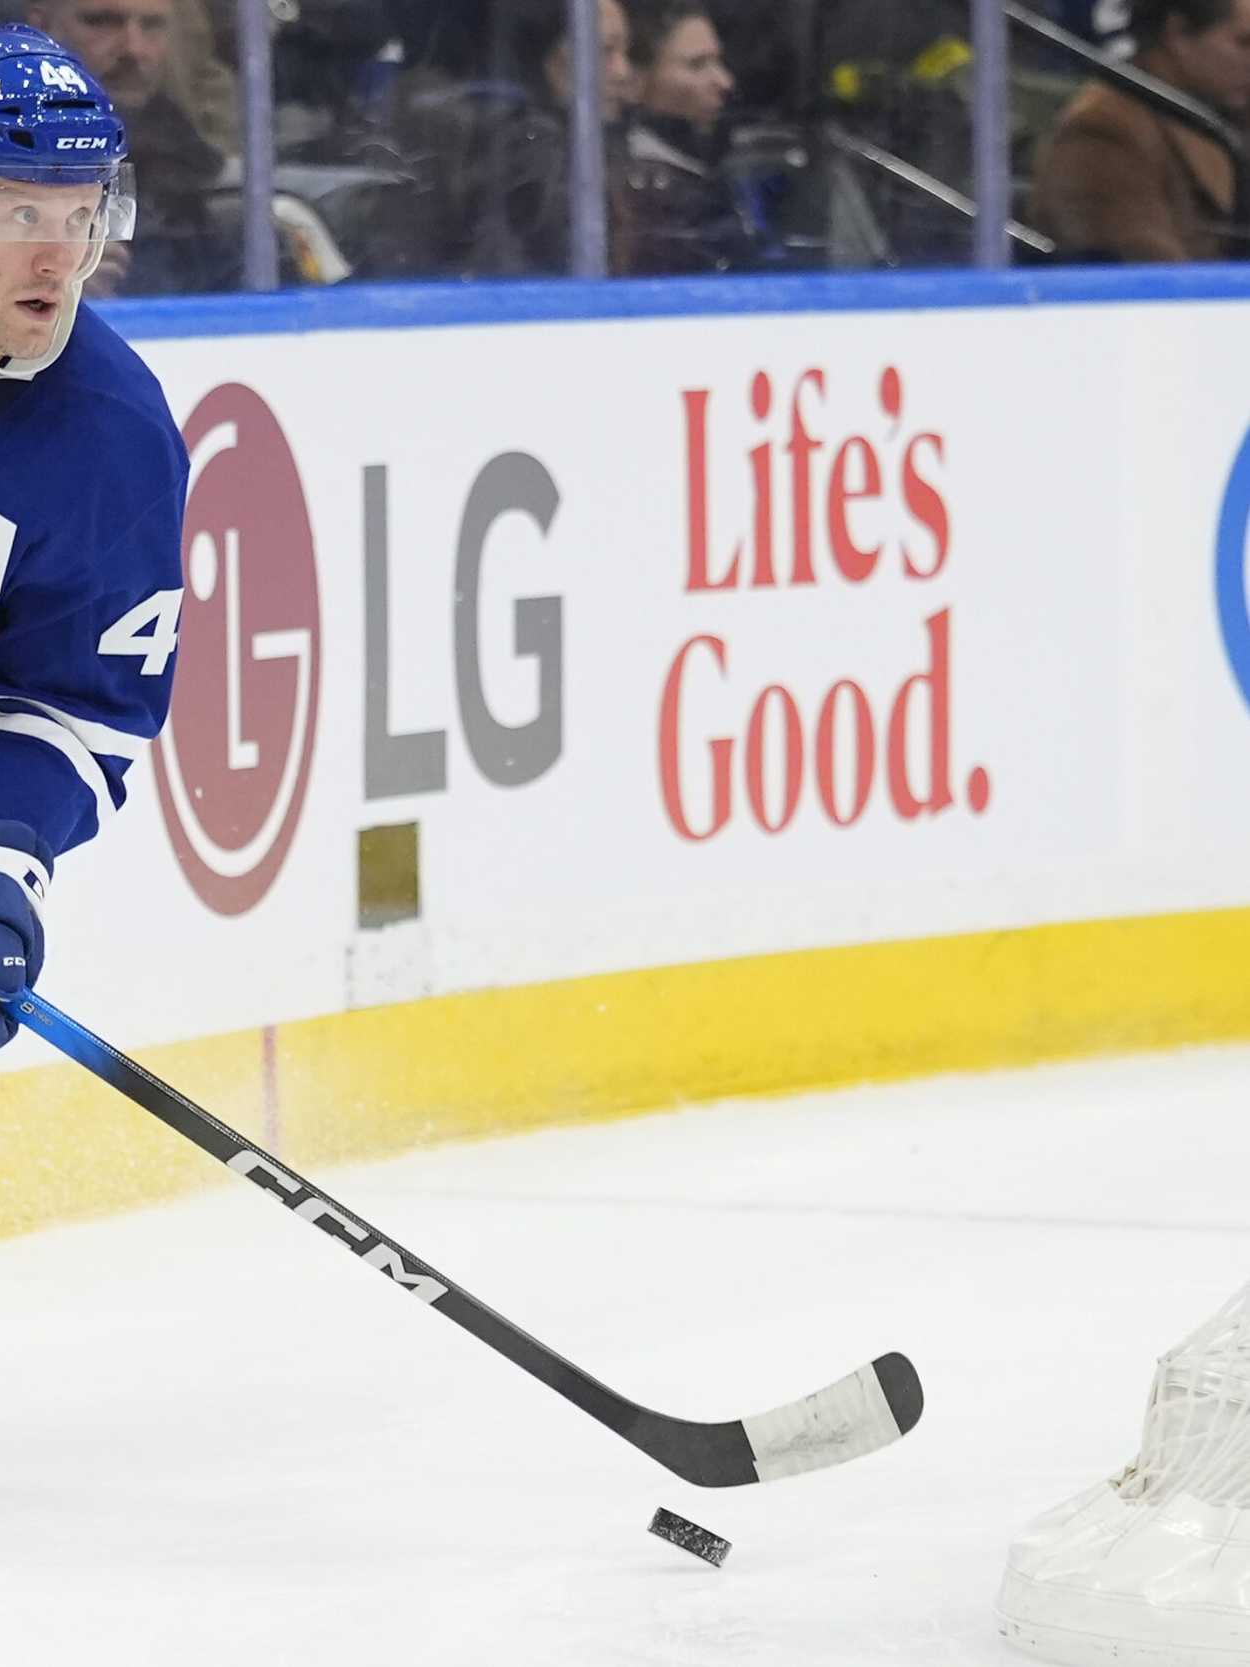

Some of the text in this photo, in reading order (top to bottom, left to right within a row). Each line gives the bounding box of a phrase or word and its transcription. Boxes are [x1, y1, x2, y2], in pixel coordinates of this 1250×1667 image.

[40, 60, 87, 94] 44
[56, 137, 108, 150] CCM
[681, 365, 950, 594] Life's
[97, 588, 184, 676] 4
[363, 452, 563, 801] LG
[658, 606, 990, 842] Good.
[227, 1150, 449, 1305] CCM
